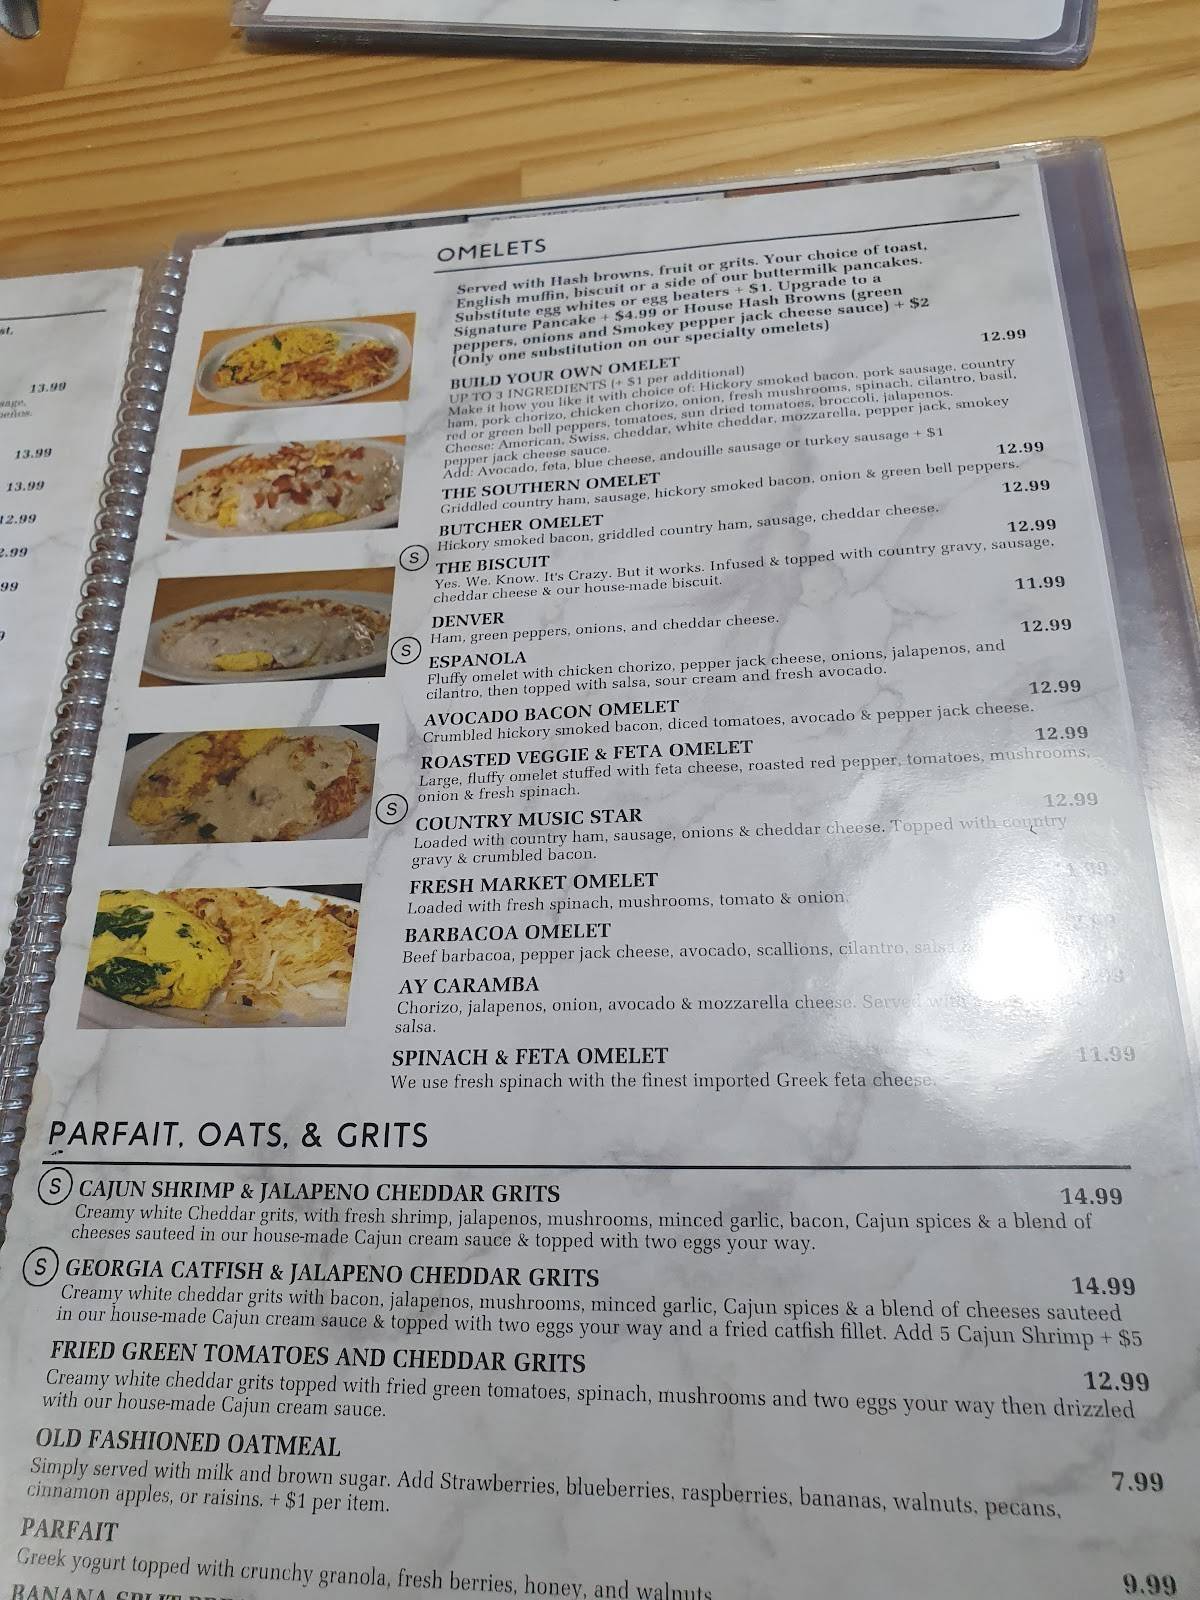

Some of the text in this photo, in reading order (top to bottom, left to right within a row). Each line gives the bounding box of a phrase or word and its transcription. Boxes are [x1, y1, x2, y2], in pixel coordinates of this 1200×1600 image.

[437, 238, 546, 262] OMELETS
[457, 280, 506, 294] Served
[513, 277, 544, 289] with
[551, 273, 588, 286] Hash
[659, 263, 692, 275] fruit
[698, 263, 714, 271] or
[764, 254, 802, 264] Your
[807, 248, 857, 260] choice
[863, 244, 880, 255] of
[981, 329, 1026, 342] 12.99
[451, 356, 680, 389] BUILD YOUR OWN OMELET
[14, 448, 52, 460] 13.99
[996, 441, 1044, 454] 12.99
[6, 480, 45, 492] 13.99
[441, 472, 660, 500] THE SOUTHERN OMELET
[1002, 479, 1050, 492] 12.99
[437, 504, 938, 551] Hickory smoked bacon, griddled country ham, sausage, cheddar cheese.
[439, 514, 604, 536] BUTCHER OMELET
[1008, 519, 1056, 532] 12.99
[409, 552, 419, 564] S
[435, 555, 550, 574] THE BISCUIT
[1015, 576, 1065, 589] 11.99
[431, 611, 504, 629] DENVER
[1020, 618, 1071, 632] 12.99
[401, 645, 411, 657] S
[429, 651, 527, 669] ESPANOLA
[1029, 679, 1081, 694] 12.99
[423, 699, 679, 726] AVOCADO BACON OMELET
[423, 702, 1034, 743] Crumbled hickory smoked bacon, diced tomatoes, avocado & pepper jack cheese.
[1035, 726, 1088, 740] 12.99
[420, 740, 753, 769] ROASTED VEGGIE & FETA OMELET
[1043, 792, 1098, 807] 12.99
[386, 803, 397, 816] S
[416, 808, 643, 831] COUNTRY MUSIC STAR
[409, 872, 658, 894] FRESH MARKET OMELET
[408, 899, 462, 914] Loaded
[468, 898, 501, 912] with
[507, 897, 544, 911] fresh
[549, 895, 612, 912] spinach,
[619, 894, 713, 908] mushrooms,
[720, 893, 774, 905] tomato
[780, 893, 791, 904] &
[404, 923, 611, 943] BARBACOA OMELET
[398, 976, 539, 994] AY CARAMBA
[392, 1047, 668, 1066] SPINACH & FETA OMELET
[1078, 1046, 1135, 1062] 11.99
[391, 1075, 416, 1088] We
[422, 1079, 448, 1088] use
[454, 1072, 493, 1088] fresh
[499, 1072, 562, 1092] spinach
[568, 1072, 604, 1087] with
[611, 1072, 636, 1087] the
[642, 1072, 687, 1087] finest
[693, 1072, 770, 1092] imported
[777, 1072, 828, 1087] Greek
[834, 1072, 866, 1086] feta
[48, 1120, 427, 1149] PARFAIT, OATS, & GRITS
[49, 1178, 62, 1195] S
[79, 1180, 560, 1203] CAJUN SHRIMP & JALAPENO CHEDDAR GRITS
[1060, 1187, 1122, 1205] 14.99
[71, 1223, 815, 1255] cheeses sauteed in our house-made Cajun cream sauce & topped with two eggs your way.
[34, 1258, 48, 1276] S
[65, 1258, 599, 1287] GEORGIA CATFISH & JALAPENO CHEDDAR GRITS
[1072, 1277, 1135, 1295] 14.99
[50, 1340, 585, 1373] FRIED GREEN TOMATOES AND CHEDDAR GRITS
[1083, 1371, 1149, 1391] 12.99
[36, 1428, 340, 1456] OLD FASHIONED OATMEAL
[1112, 1471, 1163, 1492] 7.99
[20, 1517, 119, 1541] PARFAIT
[1123, 1574, 1177, 1596] 9.99
